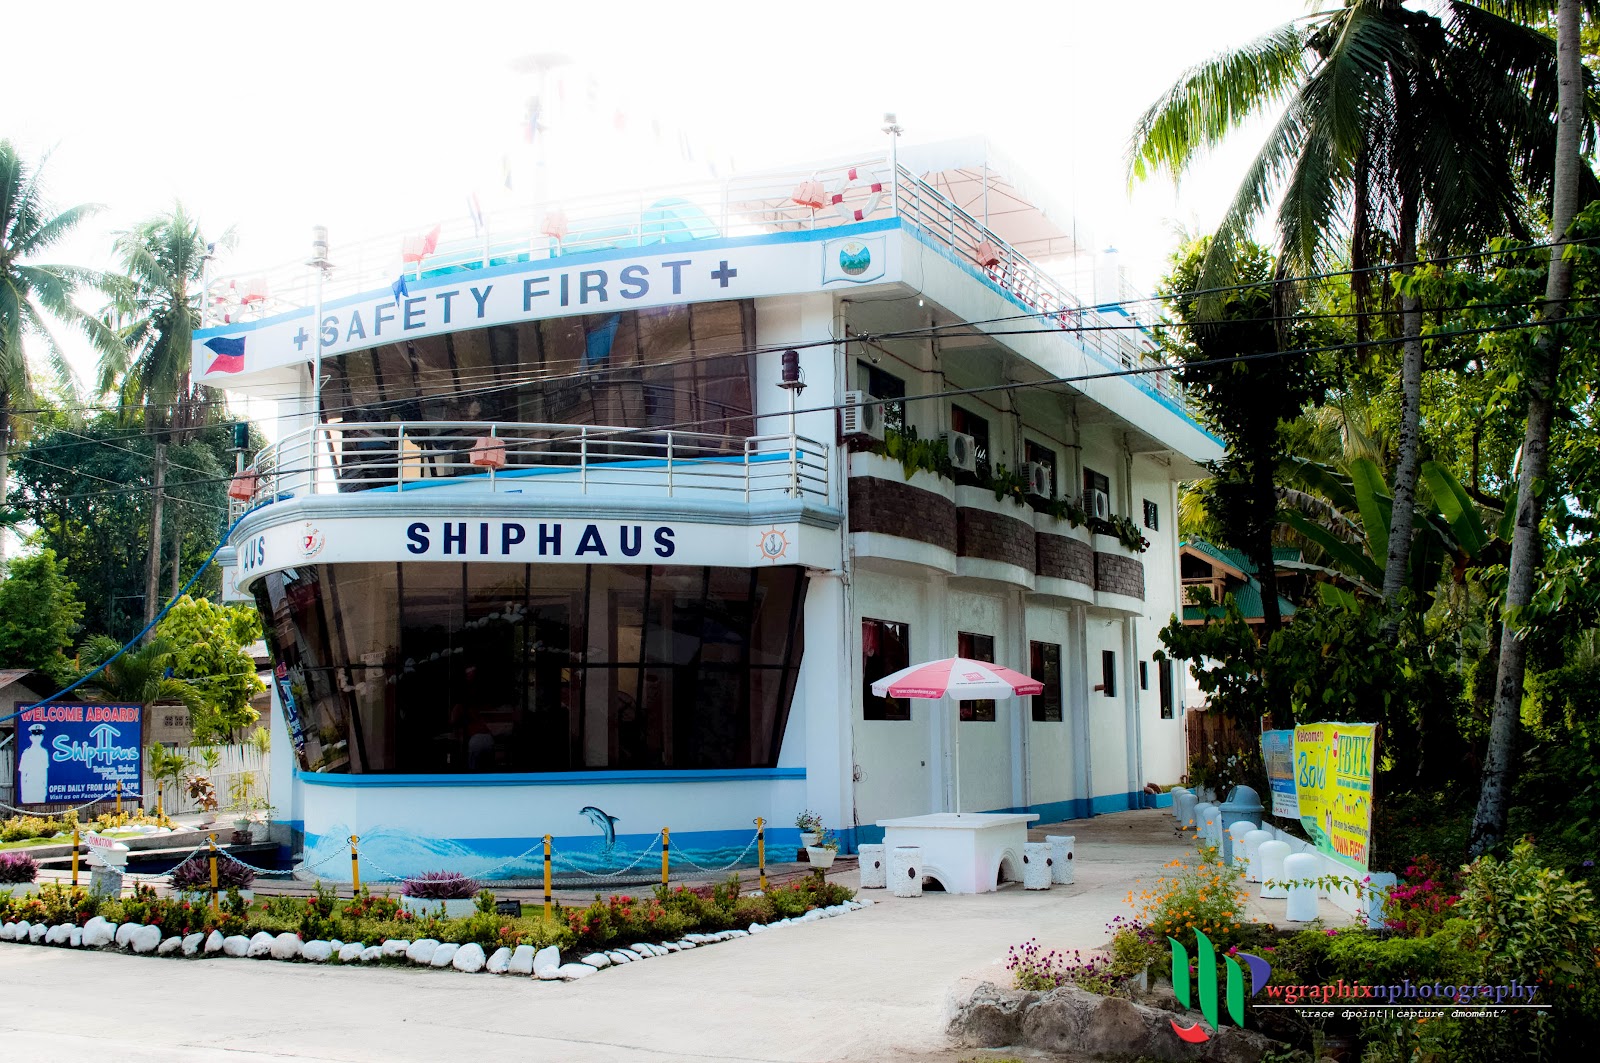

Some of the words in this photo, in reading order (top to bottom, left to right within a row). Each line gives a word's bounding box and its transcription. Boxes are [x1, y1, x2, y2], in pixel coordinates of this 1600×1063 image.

[320, 284, 494, 348] SAFETY
[523, 259, 692, 312] FIRST
[406, 522, 676, 557] SHIPHAUS
[20, 706, 83, 722] WELCOME
[86, 707, 139, 722] ABOARD!
[52, 723, 140, 768] ShipHaus
[49, 784, 67, 793] OPEN
[68, 784, 86, 792] DAILY
[86, 783, 103, 792] FROM
[89, 836, 112, 848] DONATION
